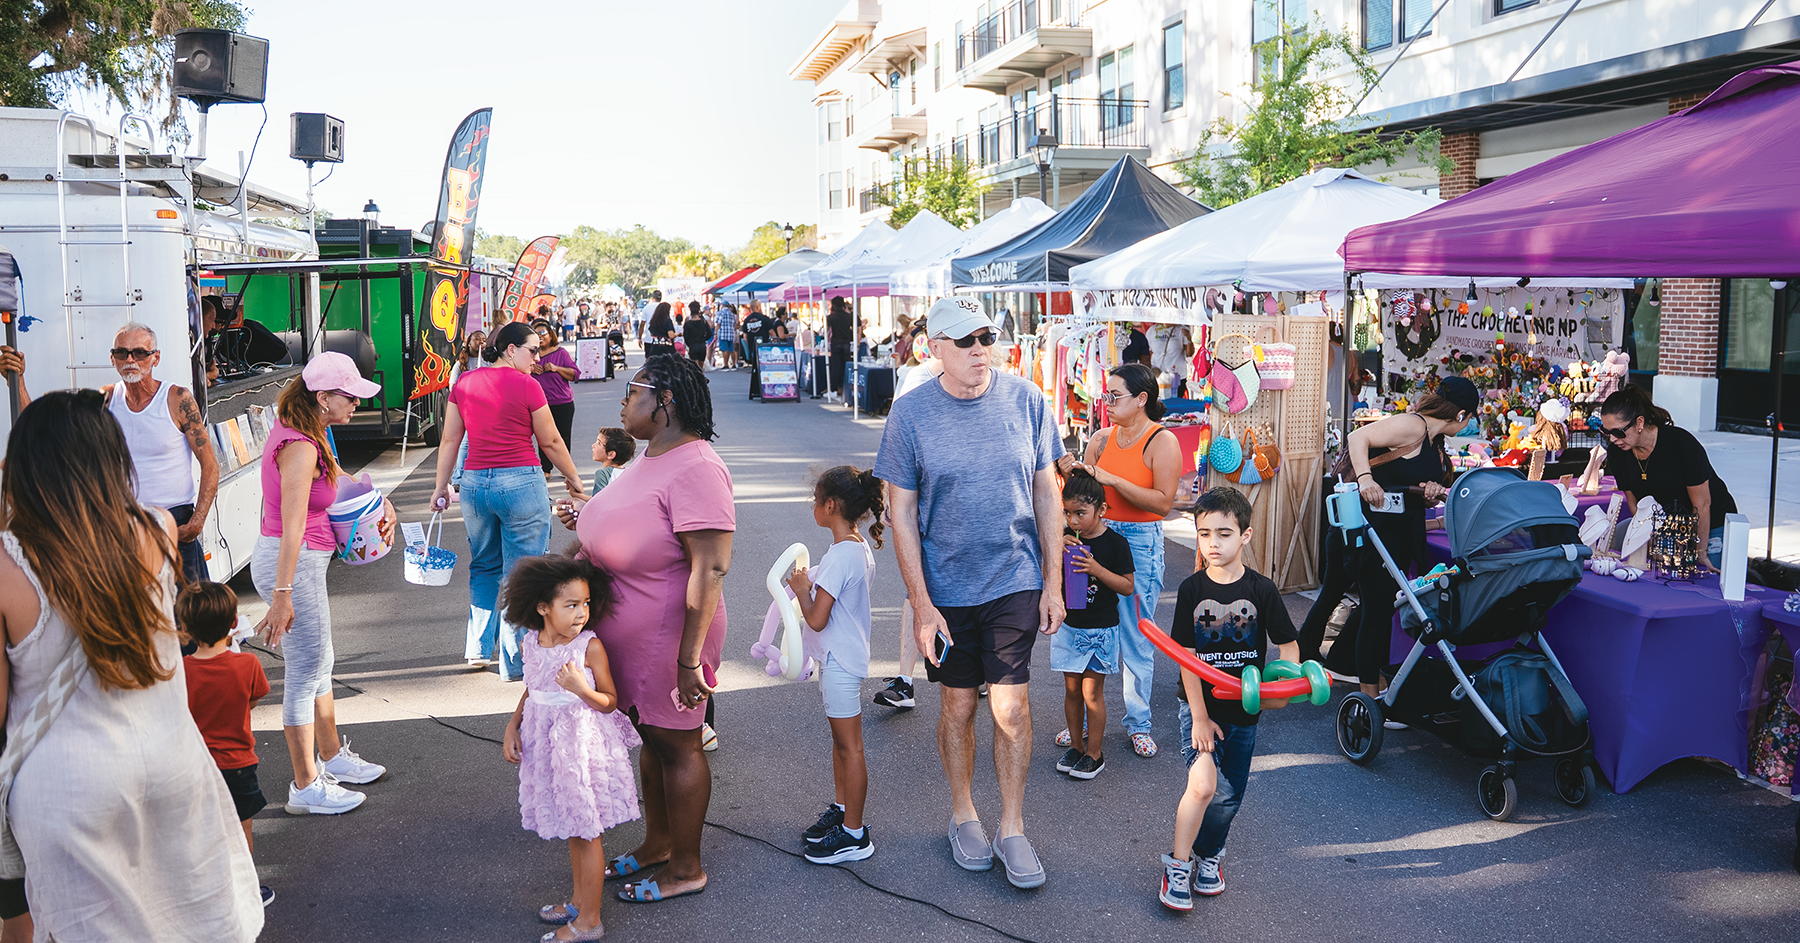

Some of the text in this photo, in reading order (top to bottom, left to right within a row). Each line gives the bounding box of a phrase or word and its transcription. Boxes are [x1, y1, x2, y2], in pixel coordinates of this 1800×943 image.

[431, 166, 472, 342] BBQ
[969, 260, 1018, 283] WELCOME
[956, 299, 979, 313] UCF
[1099, 286, 1197, 309] THE ROCHETING NP
[1447, 309, 1467, 328] THE
[1559, 317, 1578, 338] NP
[1200, 652, 1223, 661] WENT
[1224, 649, 1258, 660] OUTSIDE
